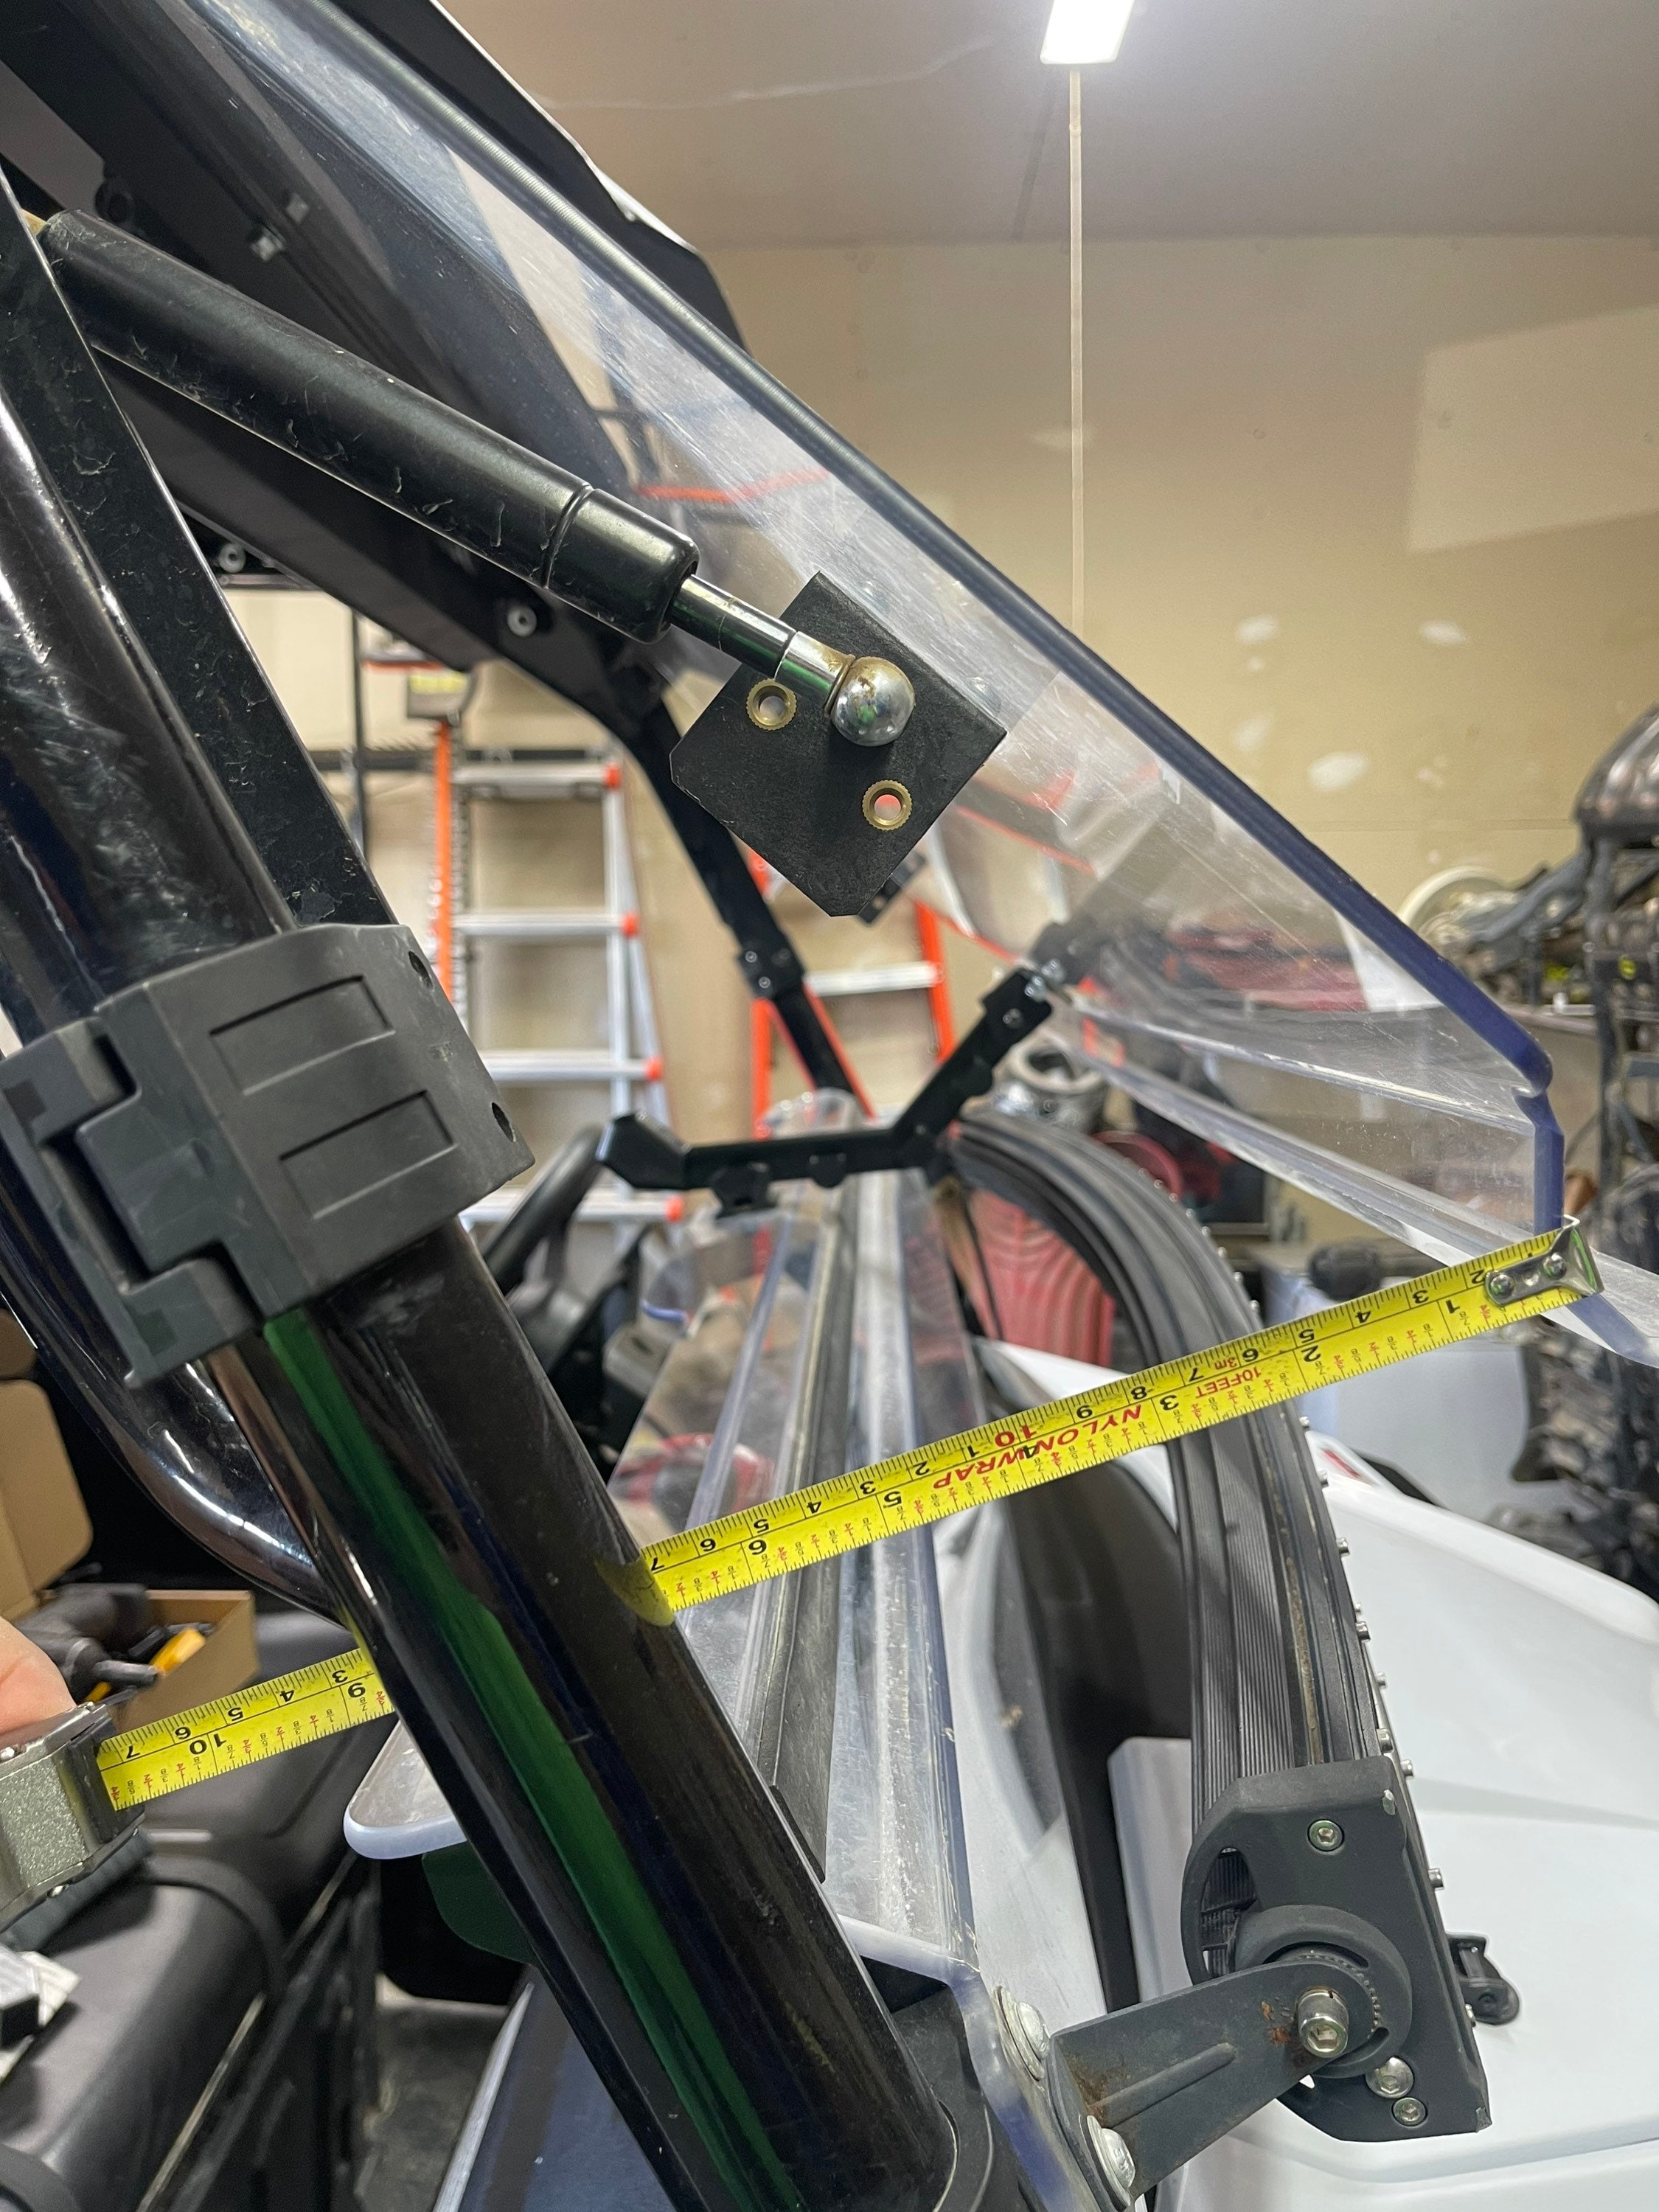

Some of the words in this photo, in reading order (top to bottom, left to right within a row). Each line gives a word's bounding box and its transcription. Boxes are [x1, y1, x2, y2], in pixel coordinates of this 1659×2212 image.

[1469, 1269, 1486, 1284] 2
[1412, 1290, 1429, 1304] 3
[1445, 1299, 1461, 1314] 1
[1354, 1310, 1371, 1324] 4
[1298, 1329, 1315, 1343] 5
[1242, 1348, 1259, 1363] 6
[1301, 1344, 1321, 1363] 2
[1214, 1357, 1237, 1371] 3m
[1189, 1367, 1205, 1382] 7
[1130, 1385, 1147, 1400] 8
[1159, 1394, 1179, 1411] 3
[1076, 1404, 1093, 1419] 9
[967, 1444, 980, 1458] 1
[1021, 1444, 1039, 1459] 4
[912, 1460, 930, 1476] 2
[859, 1481, 876, 1495] 3
[806, 1500, 822, 1514] 4
[883, 1491, 902, 1509] 5
[753, 1518, 770, 1534] 5
[700, 1538, 717, 1552] 6
[748, 1539, 767, 1556] 6
[650, 1557, 665, 1572] 7
[331, 1669, 349, 1683] 3
[277, 1689, 295, 1703] 4
[347, 1682, 366, 1698] 9
[227, 1707, 244, 1722] 5
[172, 1726, 192, 1740] 6
[125, 1745, 141, 1759] 7
